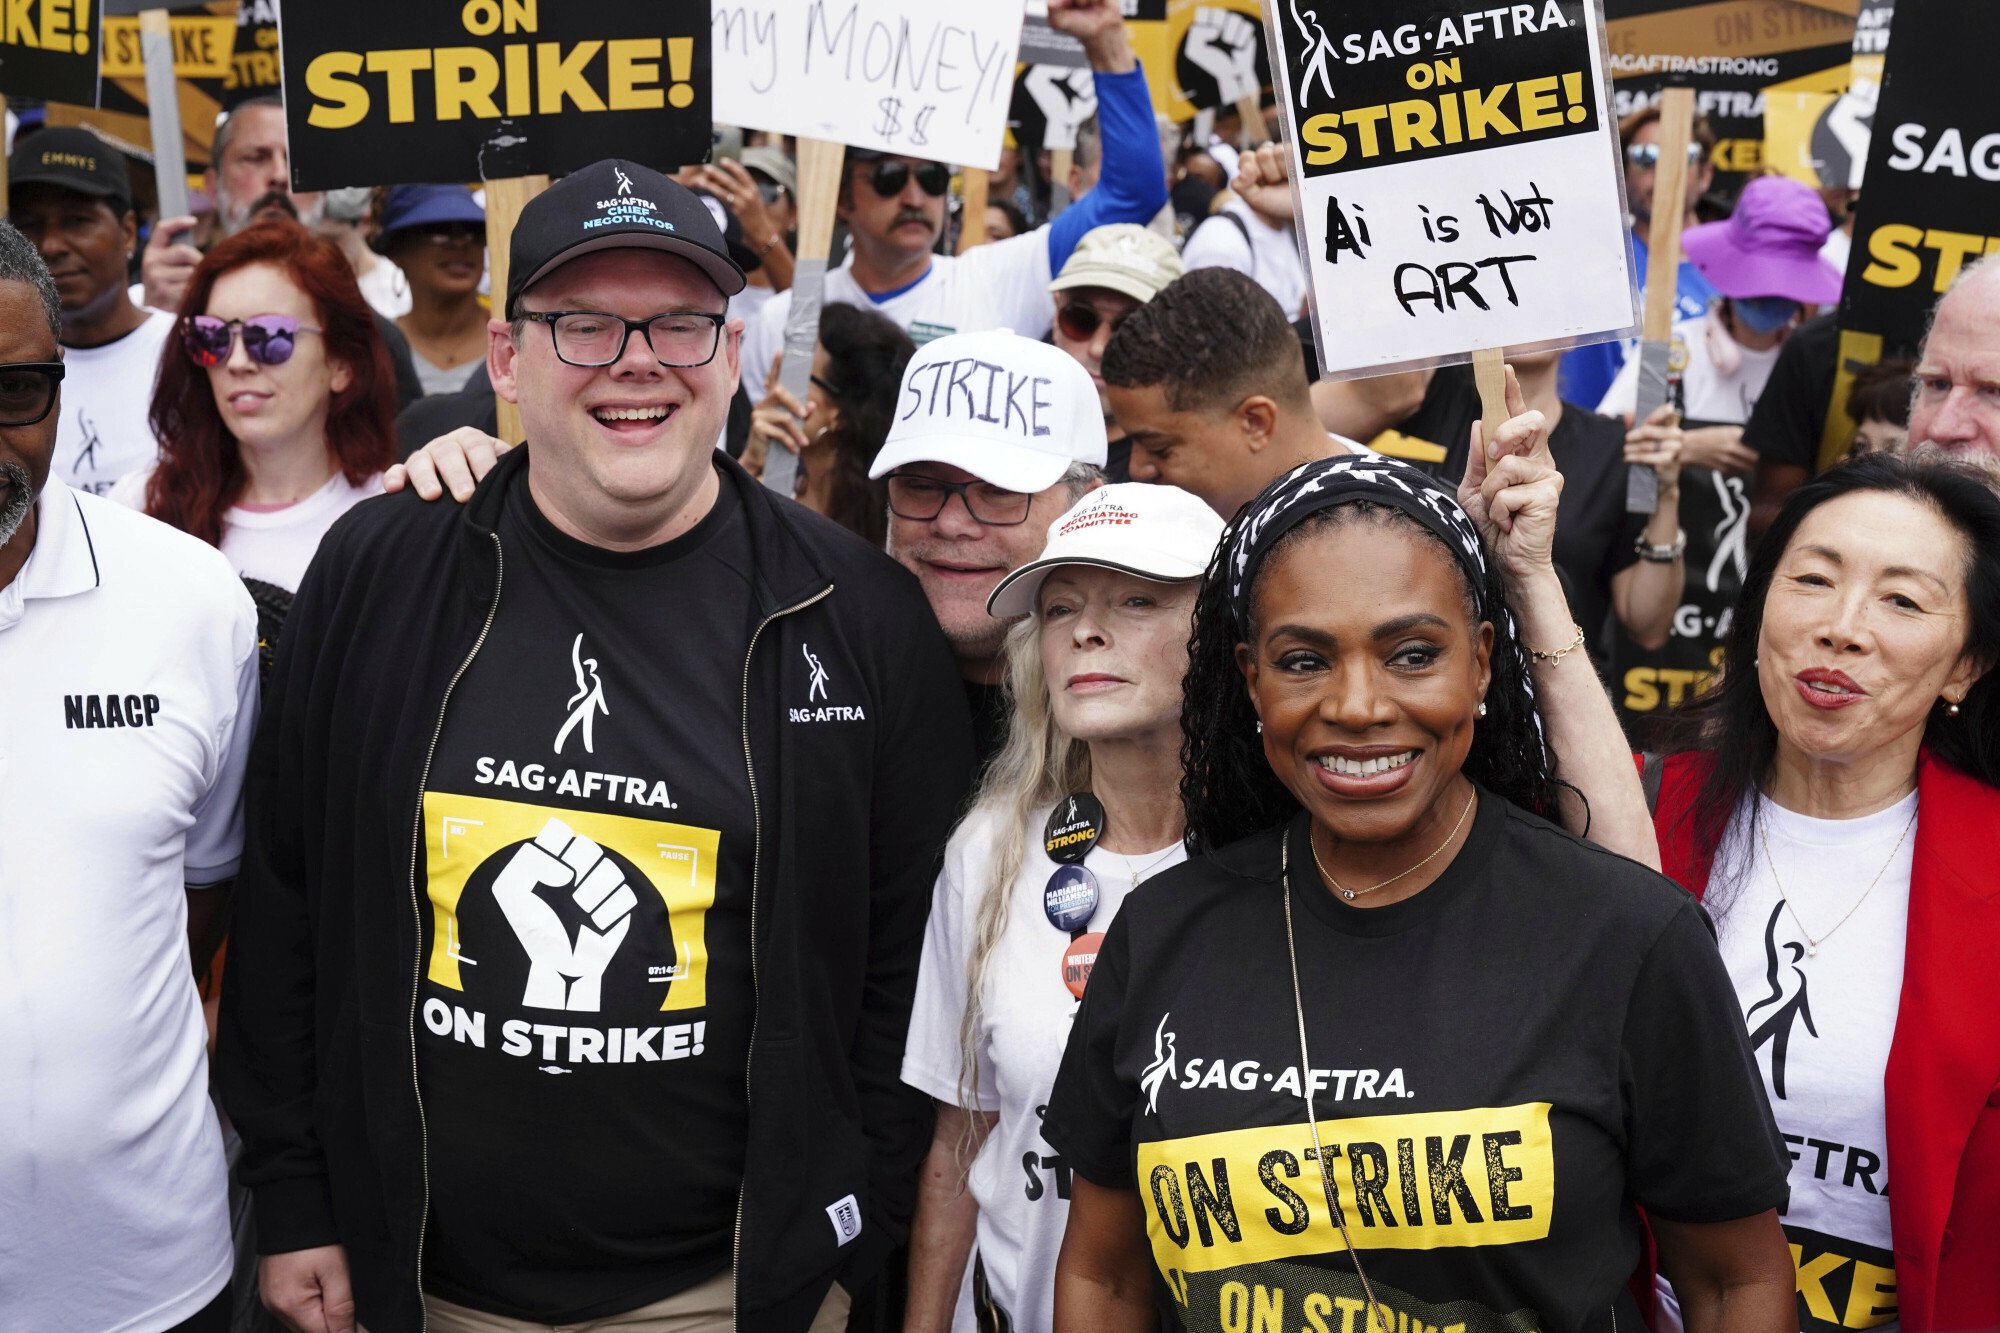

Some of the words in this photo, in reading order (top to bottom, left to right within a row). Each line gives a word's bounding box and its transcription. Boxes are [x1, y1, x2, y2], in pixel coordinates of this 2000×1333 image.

[0, 0, 91, 55] KE!
[462, 0, 539, 36] ON
[305, 36, 695, 129] STRIKE!
[1405, 57, 1463, 90] ON
[1301, 71, 1587, 166] STRIKE!
[42, 151, 97, 171] EMMYS
[583, 214, 675, 232] NEGOTIATOR
[607, 205, 650, 216] CHIEF
[1325, 195, 1372, 264] Ai
[1418, 204, 1459, 243] is
[1861, 223, 2000, 293] ST
[1393, 254, 1537, 317] ART
[901, 357, 1052, 437] STRIKE
[1058, 511, 1139, 532] NEGOTIATING
[1059, 519, 1132, 537] COMMITTEE
[64, 694, 160, 729] NAACP
[660, 850, 689, 861] PAUSE
[1046, 828, 1096, 852] STRONG
[1046, 882, 1088, 901] MARIANNE
[1046, 889, 1094, 908] WILLIAMSON
[1047, 904, 1060, 914] FOR
[1060, 895, 1094, 911] PRESIDENT
[1066, 965, 1082, 982] ON
[1084, 964, 1094, 981] S
[423, 997, 486, 1049] ON
[501, 1018, 708, 1064] STRIKE!
[1149, 1156, 1243, 1250] ON
[1257, 1129, 1533, 1237] STRIKE
[1219, 1280, 1283, 1333] ON
